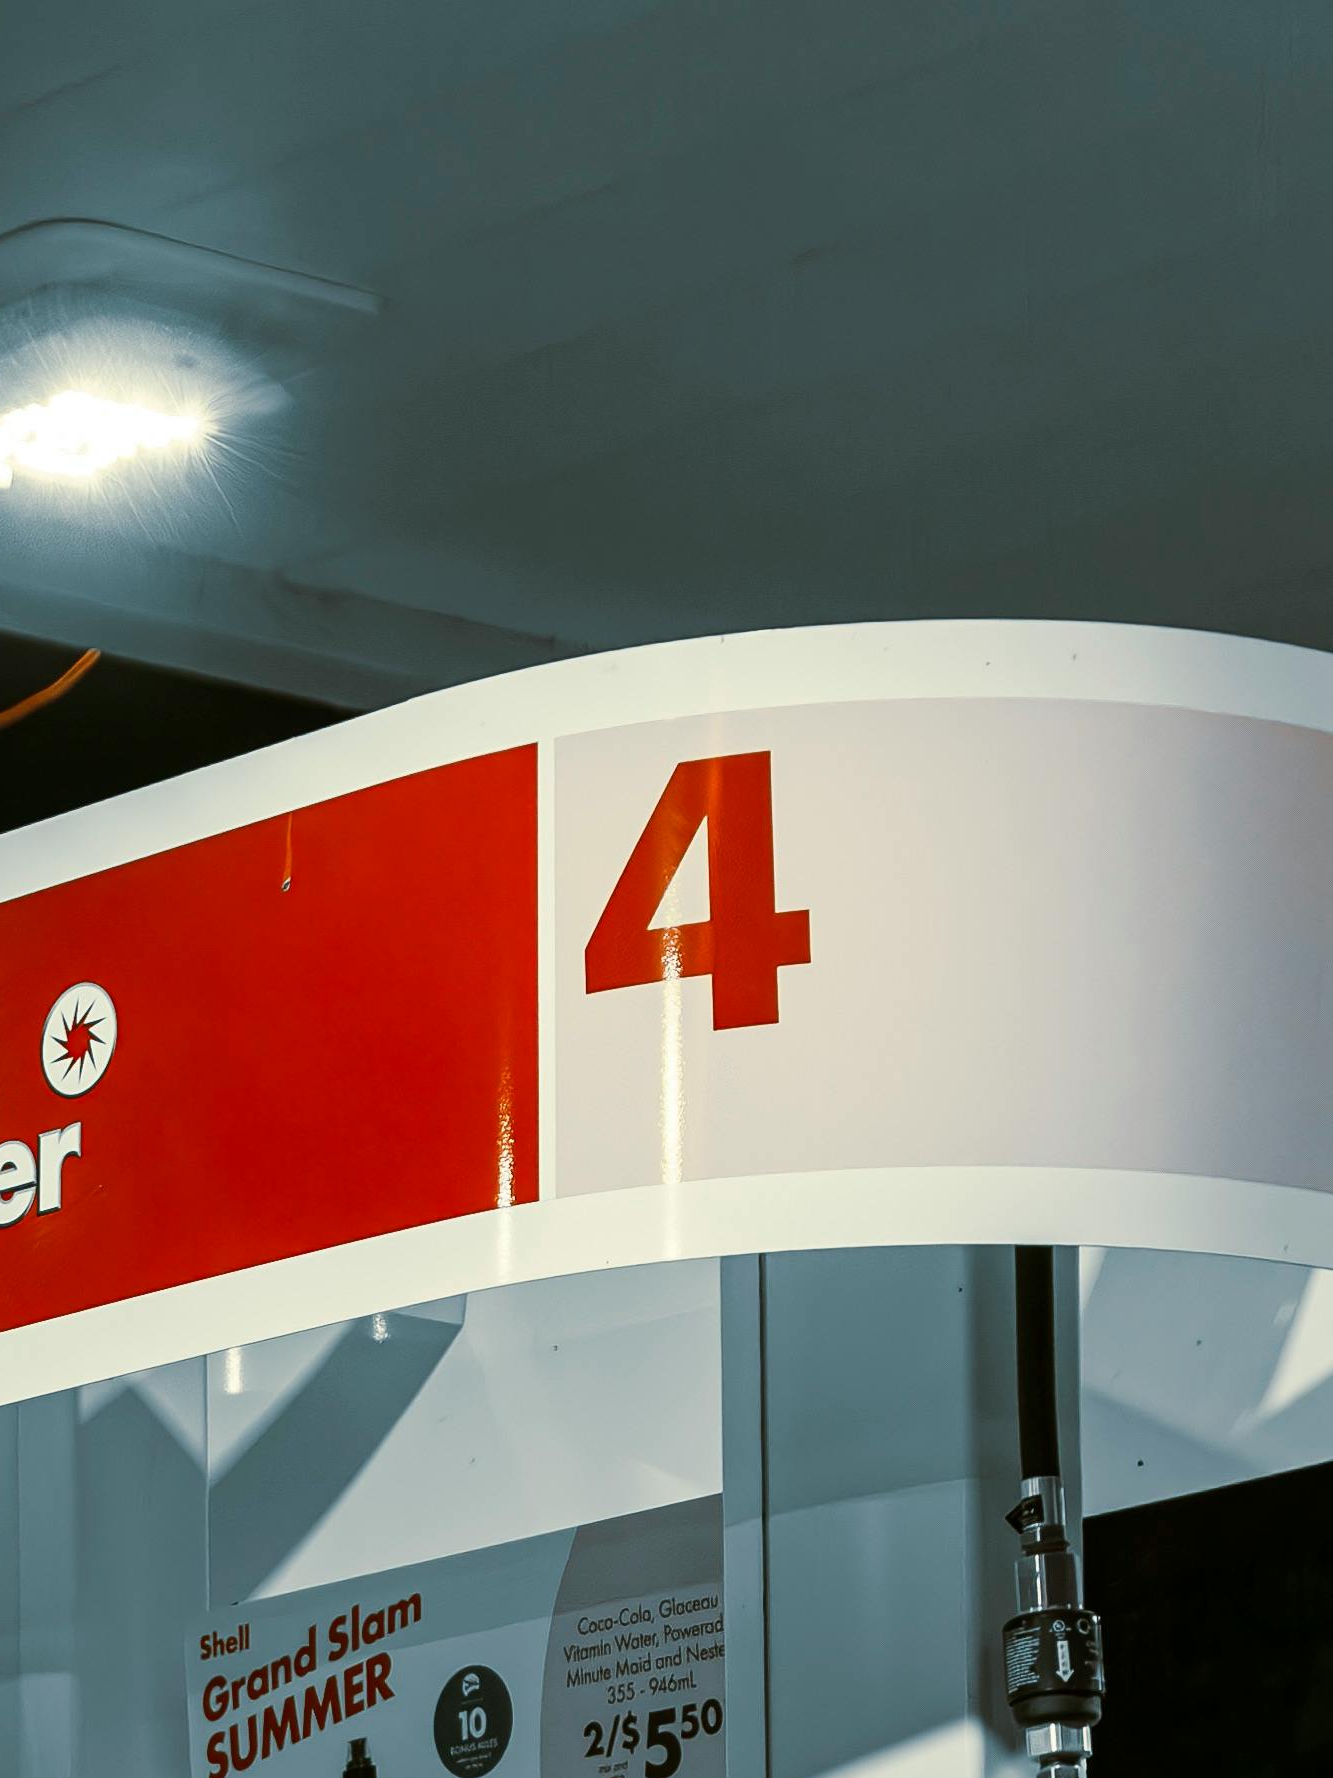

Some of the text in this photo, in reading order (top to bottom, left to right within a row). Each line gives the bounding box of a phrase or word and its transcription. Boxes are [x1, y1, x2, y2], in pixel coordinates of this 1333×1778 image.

[585, 751, 811, 1031] 4
[577, 1594, 719, 1636] Coca-Cola, Glaceau
[200, 1623, 250, 1660] Shell
[202, 1592, 422, 1722] Grand Slam
[564, 1640, 612, 1663] Vitamin
[614, 1632, 660, 1652] Water,
[566, 1665, 612, 1688] Minute
[616, 1652, 652, 1678] Maid
[655, 1650, 682, 1670] and
[607, 1682, 635, 1704] 355
[649, 1670, 697, 1696] 946mL
[458, 1706, 487, 1741] 10
